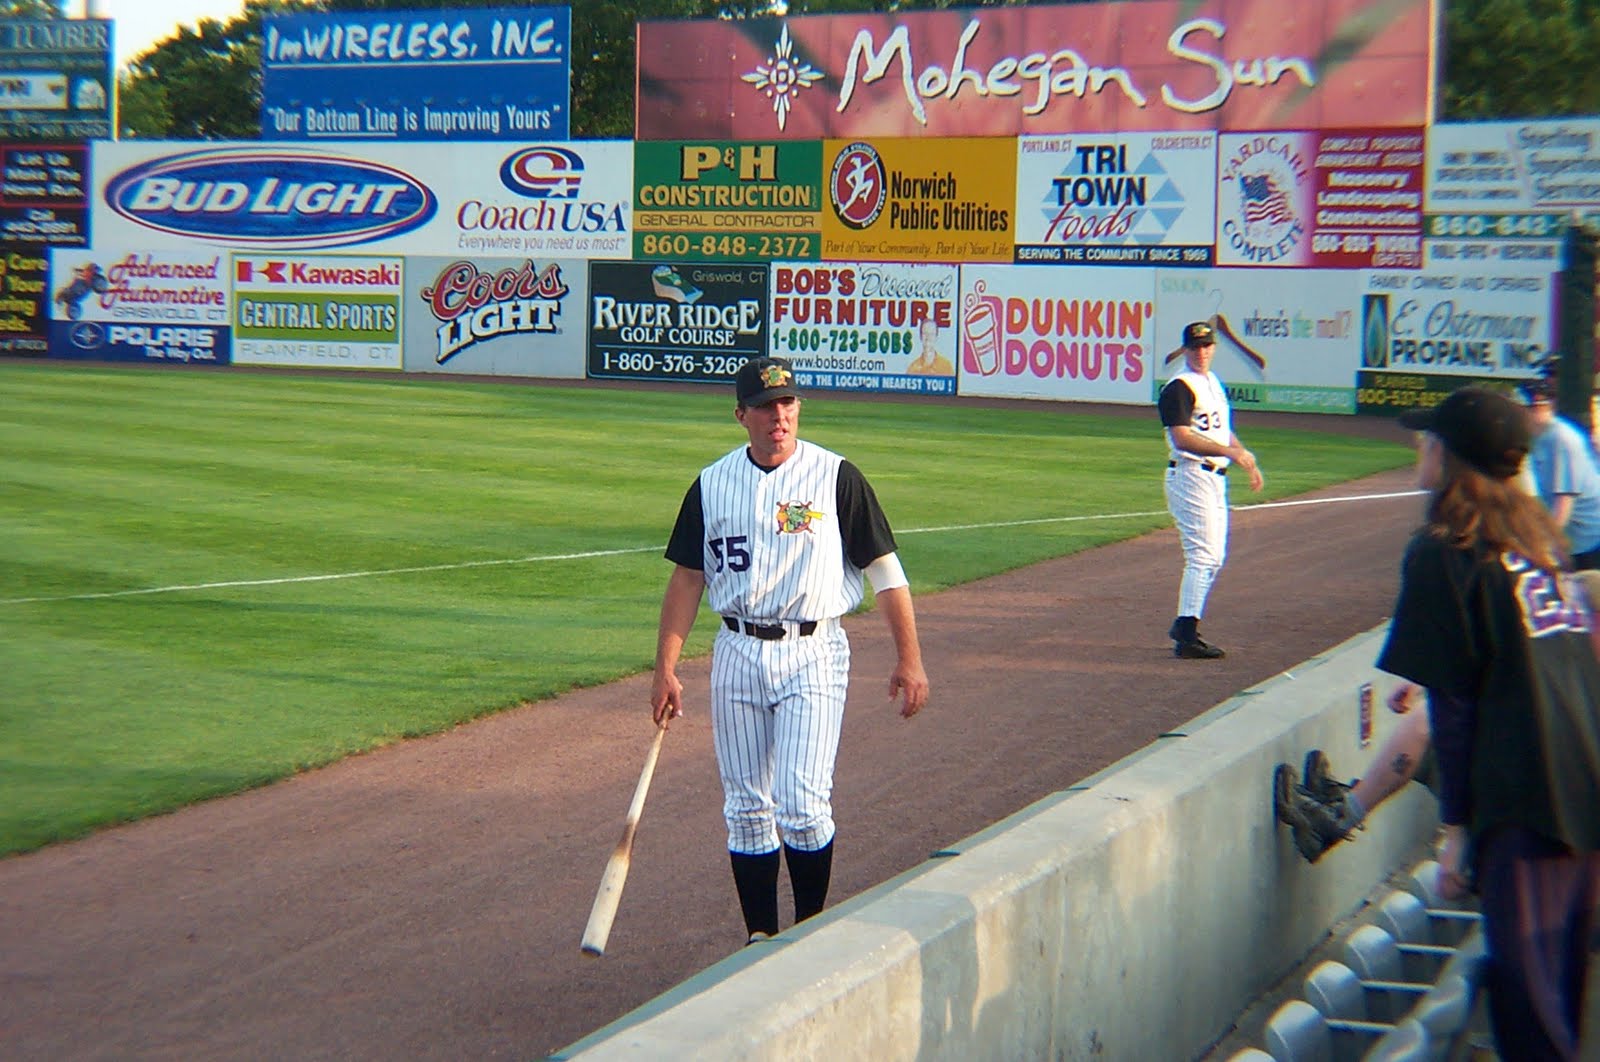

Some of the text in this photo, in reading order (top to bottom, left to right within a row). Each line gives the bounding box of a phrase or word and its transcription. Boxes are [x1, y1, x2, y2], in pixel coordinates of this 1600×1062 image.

[491, 18, 562, 57] INC.
[837, 19, 1317, 125] Mohegan Sun
[307, 107, 359, 131] Bottom
[365, 106, 398, 131] Line
[403, 106, 418, 131] is
[424, 106, 500, 134] Improving
[1076, 144, 1128, 174] TRI
[890, 171, 956, 200] Norwich
[1052, 176, 1147, 206] TOWN
[1328, 171, 1410, 189] Masonry
[129, 177, 409, 215] BUD LIGHT
[639, 185, 810, 208] CONSTRUCTION
[1317, 191, 1419, 208] Landscaping
[456, 200, 626, 232] Coach USA
[640, 213, 814, 227] GENERAL CONTRACTOR
[889, 202, 1009, 232] Public Utilities
[1044, 198, 1138, 242] foods
[1317, 209, 1419, 226] Construction
[458, 233, 521, 251] Everywhere
[524, 236, 543, 251] you
[546, 236, 574, 250] need
[576, 238, 589, 250] us
[643, 234, 810, 257] 860-848-2372
[826, 240, 845, 253] Part
[857, 241, 876, 253] Your
[936, 242, 956, 254] Part
[968, 242, 989, 255] Your
[1018, 247, 1061, 260] SERVING
[1064, 248, 1083, 260] THE
[1086, 248, 1147, 261] COMMUNITY
[1149, 249, 1181, 261] SINCE
[108, 253, 219, 284] Advanced
[291, 262, 400, 286] Kawasaki
[749, 271, 765, 284] CT
[776, 267, 953, 298] BOB'S Discount
[99, 279, 225, 309] Automotive
[421, 259, 569, 321] Coors
[240, 299, 396, 332] CENTRAL SPORTS
[593, 296, 761, 335] RIVER RIDGE
[774, 298, 951, 328] FURNITURE
[1005, 298, 1153, 340] DUNKIN'
[1243, 309, 1289, 338] where's
[1292, 310, 1314, 338] the
[1425, 300, 1537, 339] Osterman
[109, 326, 215, 348] POLARIS
[436, 299, 562, 364] LIGHT
[620, 327, 736, 346] GOLF COURSE
[772, 328, 913, 355] 1-800-723-BOBS
[1004, 339, 1144, 383] DONUTS
[1391, 339, 1496, 372] PROPANE,
[795, 373, 812, 386] FOR
[815, 374, 834, 387] THE
[835, 374, 879, 389] LOCATION
[882, 376, 922, 391] NEAREST
[926, 378, 945, 391] YOU
[1226, 386, 1260, 402] MALL
[1198, 412, 1221, 431] 33
